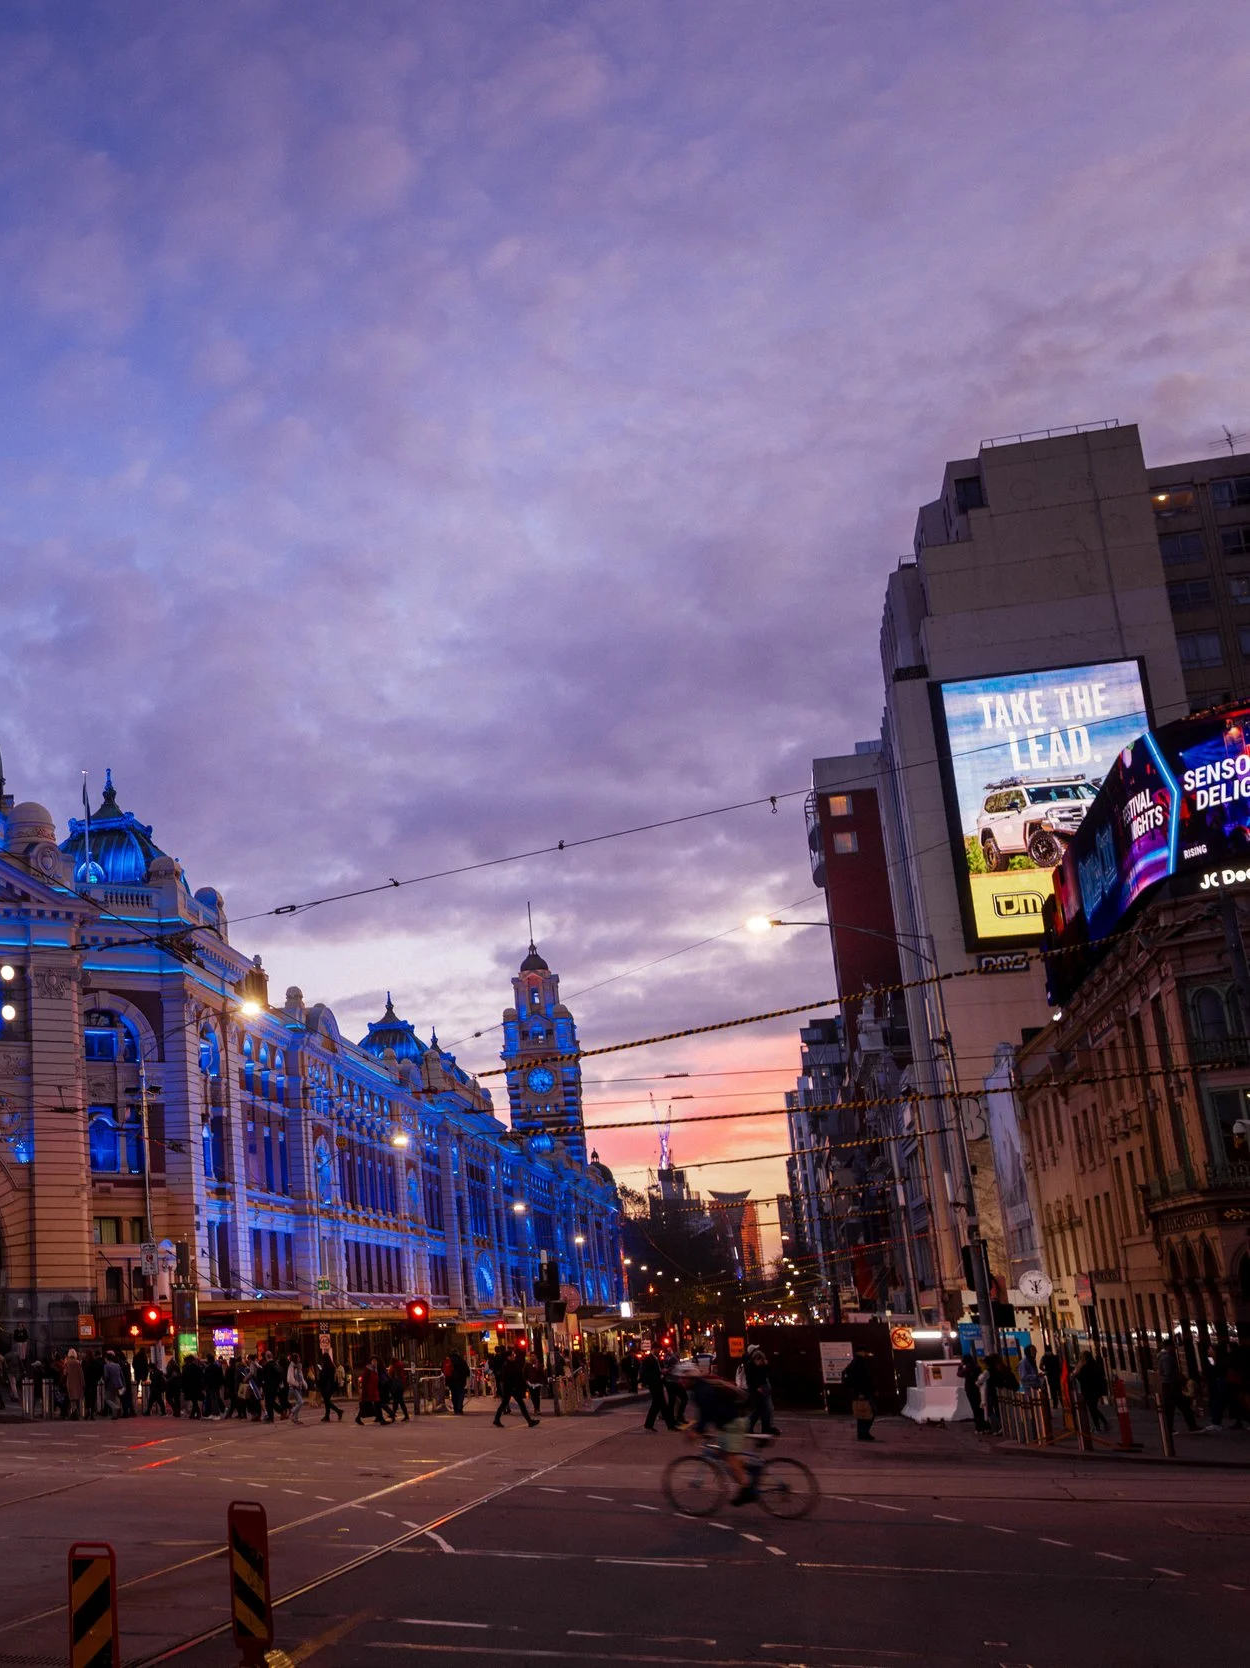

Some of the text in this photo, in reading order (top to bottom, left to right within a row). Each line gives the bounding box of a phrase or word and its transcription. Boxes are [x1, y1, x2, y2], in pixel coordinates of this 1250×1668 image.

[977, 682, 1111, 729] TAKE THE
[1009, 724, 1103, 771] LEAD.
[1184, 754, 1250, 791] SENSO
[1183, 844, 1208, 859] RISING
